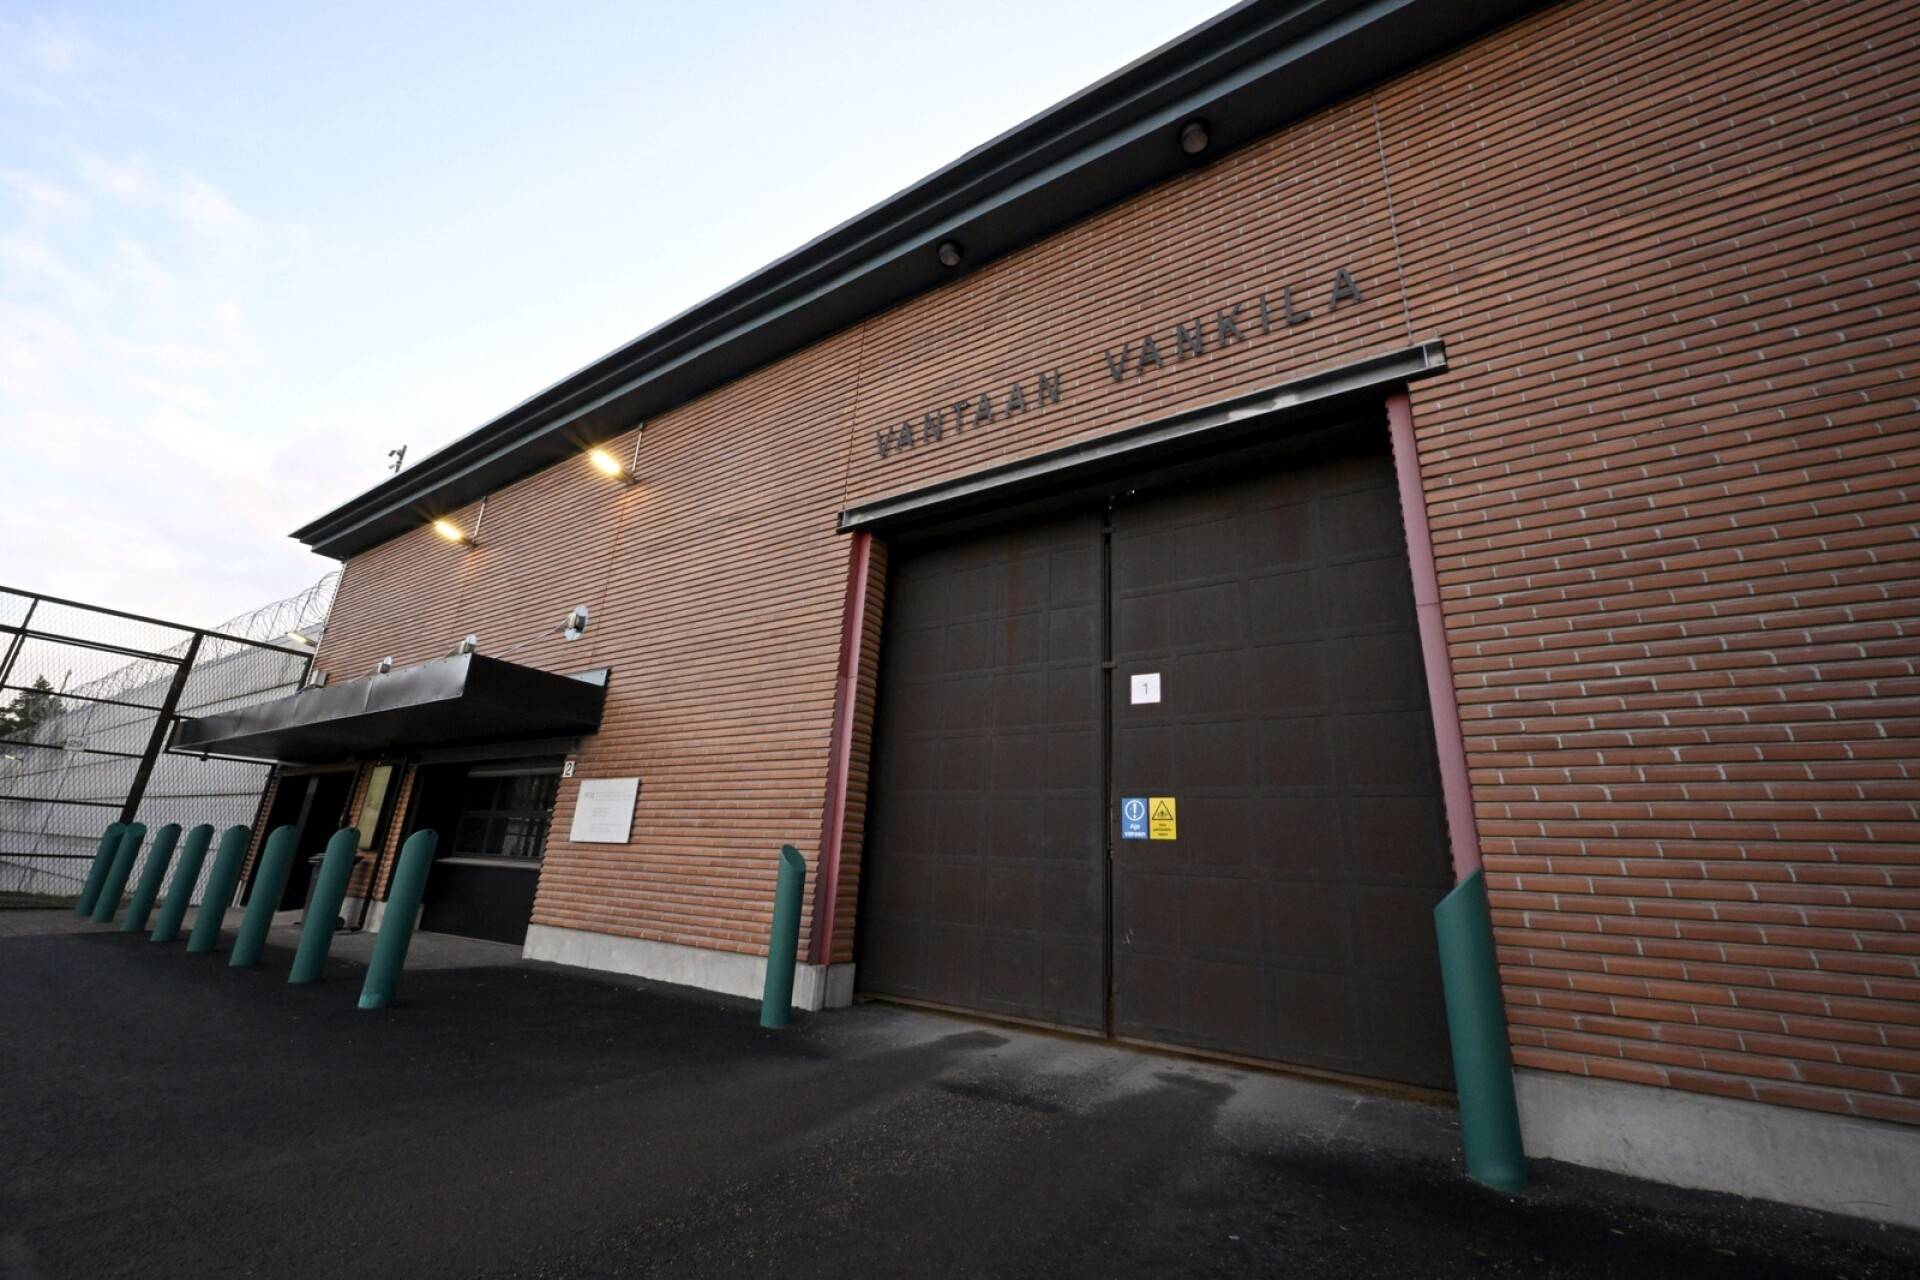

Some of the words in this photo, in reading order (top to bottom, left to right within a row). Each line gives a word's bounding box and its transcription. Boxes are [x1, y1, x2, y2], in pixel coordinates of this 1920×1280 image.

[876, 368, 1060, 459] VANTAAN
[1104, 268, 1361, 382] VANKILA
[1142, 682, 1148, 695] 1
[564, 762, 573, 776] 2
